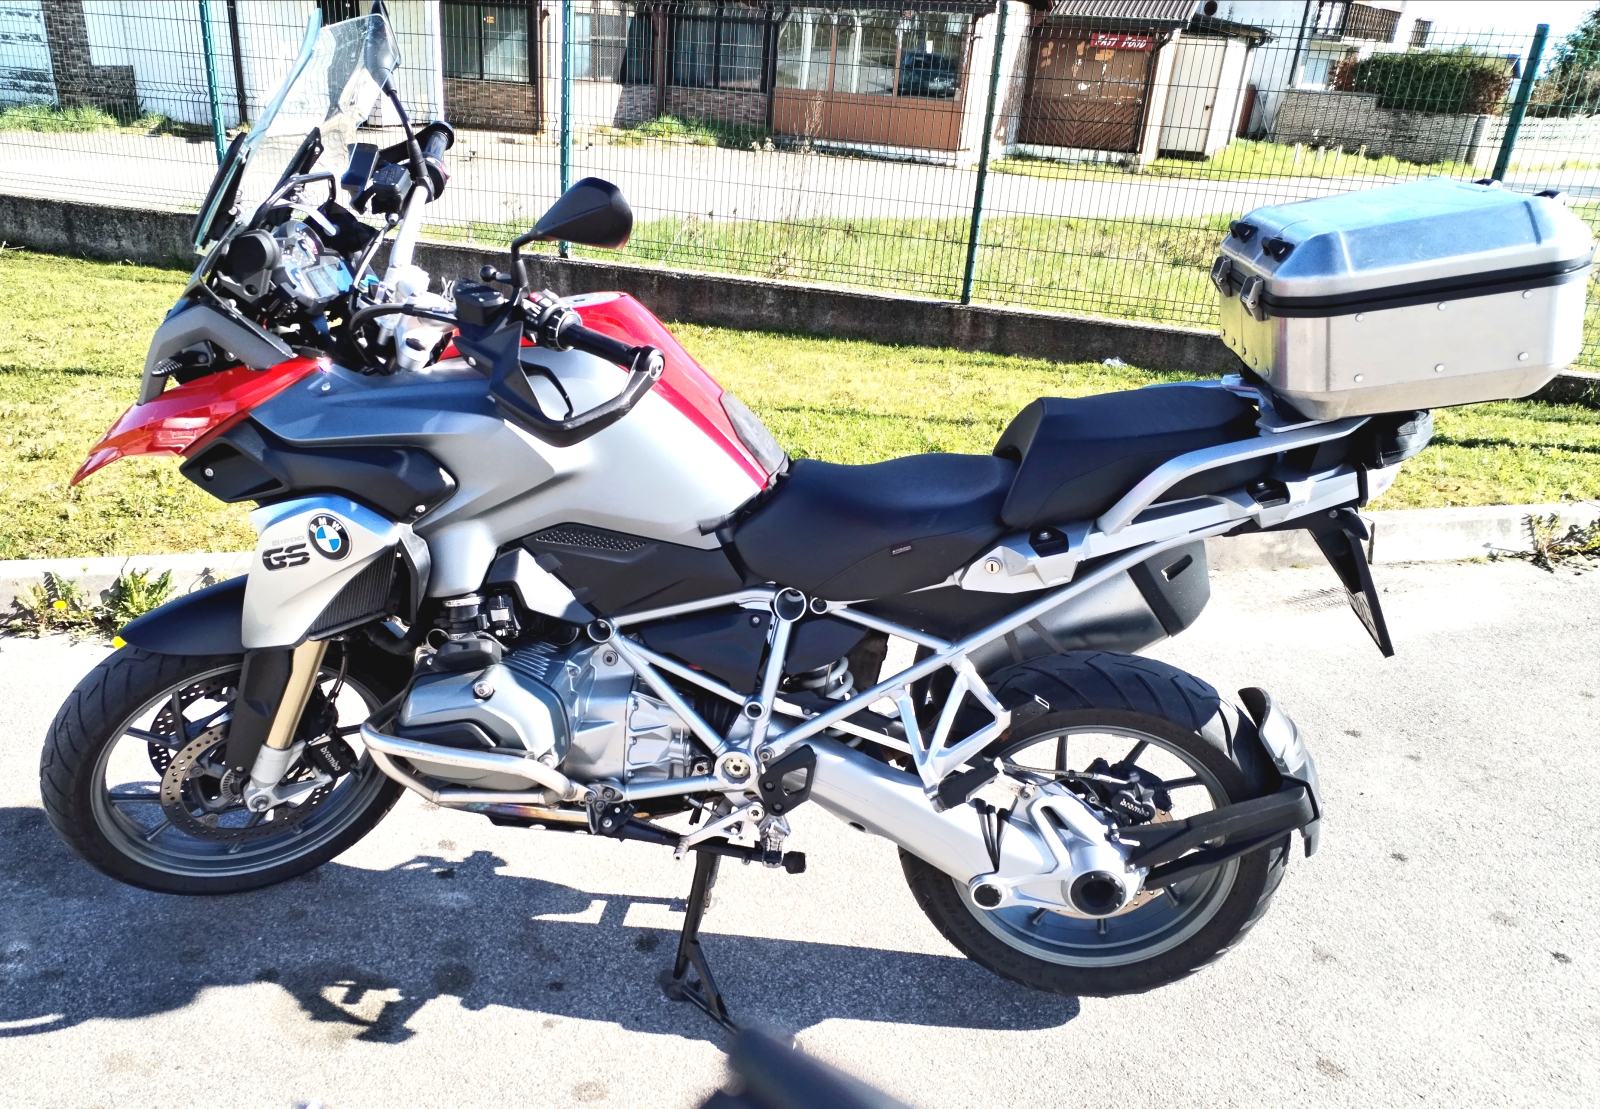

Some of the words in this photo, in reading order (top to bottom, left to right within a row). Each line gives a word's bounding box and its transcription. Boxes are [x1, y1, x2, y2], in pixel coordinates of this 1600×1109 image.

[310, 516, 342, 533] BMW
[262, 543, 310, 571] GS
[321, 745, 341, 771] brembo
[1120, 798, 1150, 817] brembo
